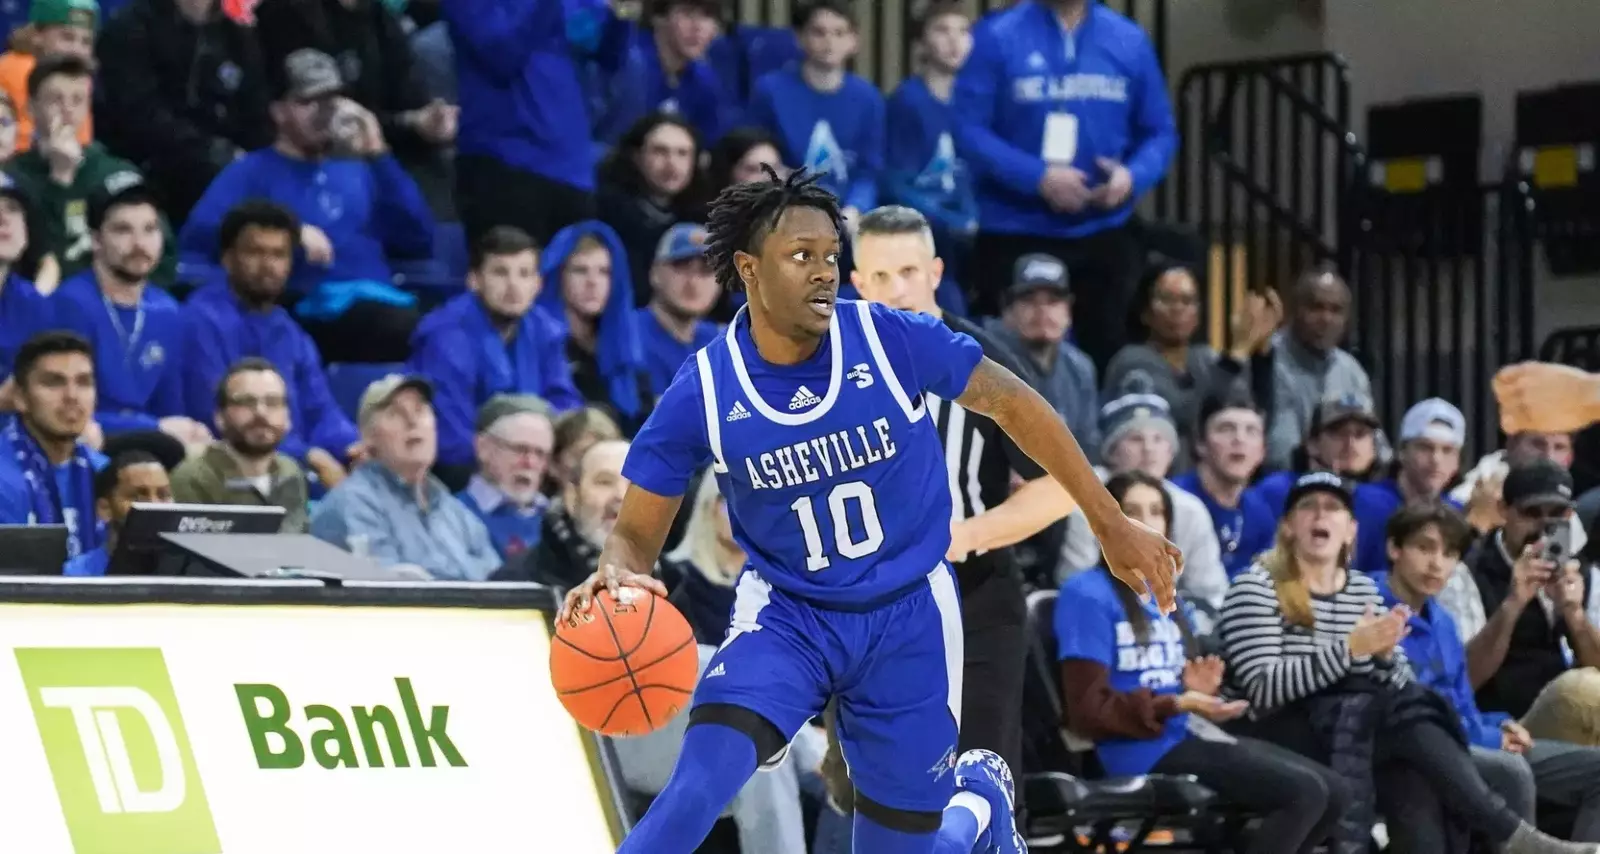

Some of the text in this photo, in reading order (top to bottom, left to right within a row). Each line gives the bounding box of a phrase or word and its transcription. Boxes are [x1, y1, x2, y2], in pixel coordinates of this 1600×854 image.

[726, 411, 752, 422] adidas
[788, 395, 822, 411] adidas
[745, 416, 896, 490] ASHEVILLE
[790, 480, 884, 572] 10
[39, 677, 468, 814] TD Bank
